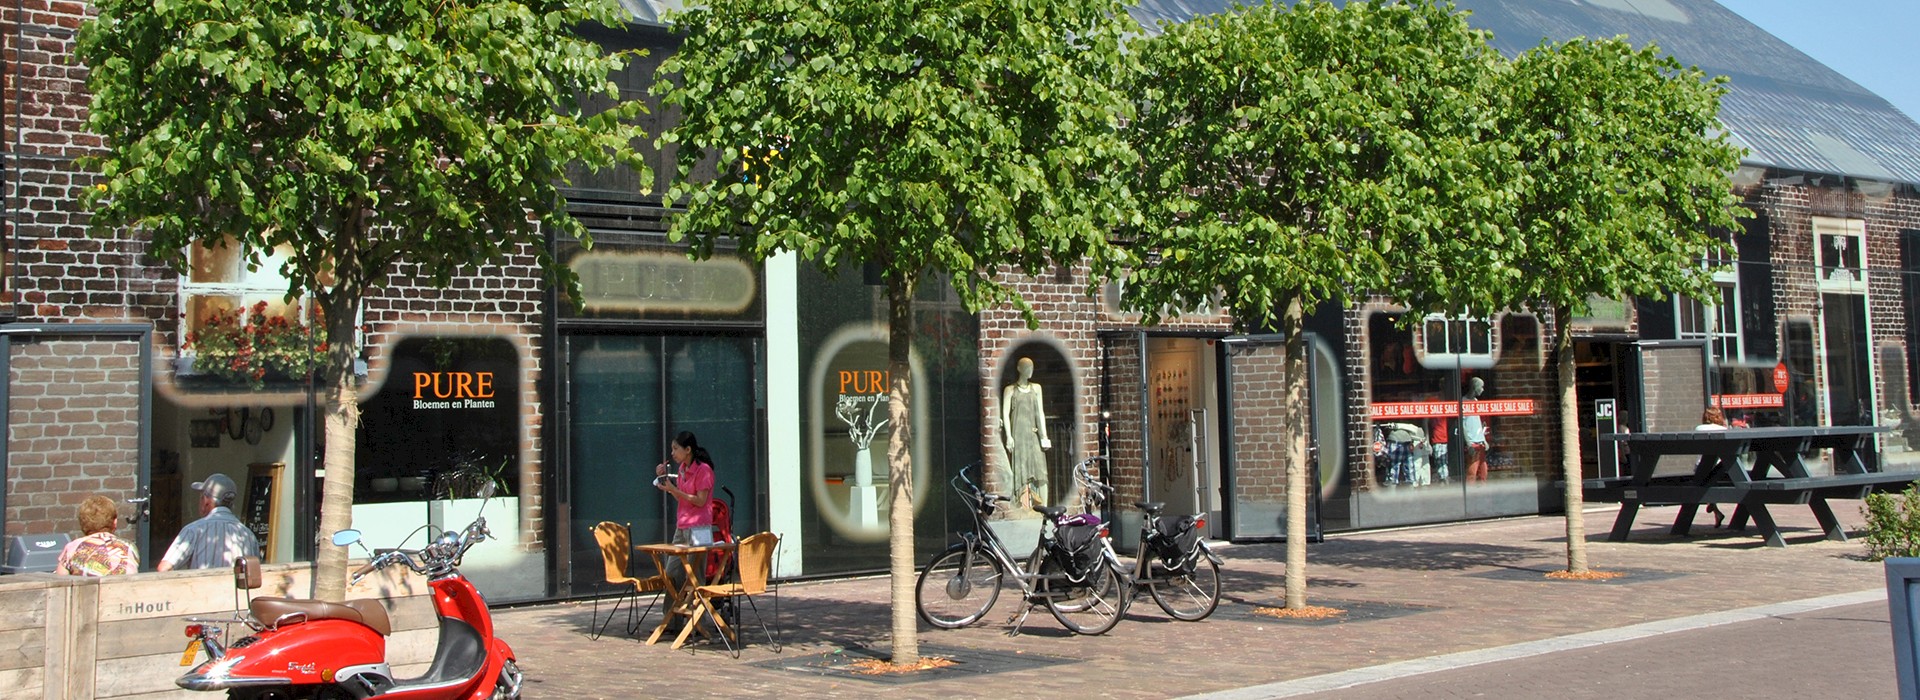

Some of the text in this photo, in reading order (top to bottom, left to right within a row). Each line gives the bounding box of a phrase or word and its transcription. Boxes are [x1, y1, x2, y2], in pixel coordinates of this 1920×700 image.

[413, 372, 495, 398] PURE
[413, 399, 495, 409] Bloemen en Planten
[839, 394, 866, 402] Bloemen
[1721, 397, 1731, 405] SALE
[1731, 397, 1741, 405] SALE
[1742, 397, 1752, 405] SALE
[1752, 396, 1762, 404] SALE
[1762, 396, 1772, 404] SALE
[1772, 396, 1782, 404] SALE
[1384, 405, 1399, 415] SALE
[1400, 405, 1414, 415] SALE
[1415, 404, 1429, 414] SALE
[1430, 404, 1443, 414] SALE
[1444, 404, 1458, 414] SALE
[1462, 403, 1475, 413] SALE
[1476, 403, 1489, 413] SALE
[1490, 402, 1503, 412] SALE
[1504, 402, 1517, 412] SALE
[1517, 402, 1530, 411] SALE
[1597, 403, 1612, 416] JC
[120, 601, 171, 614] inHout
